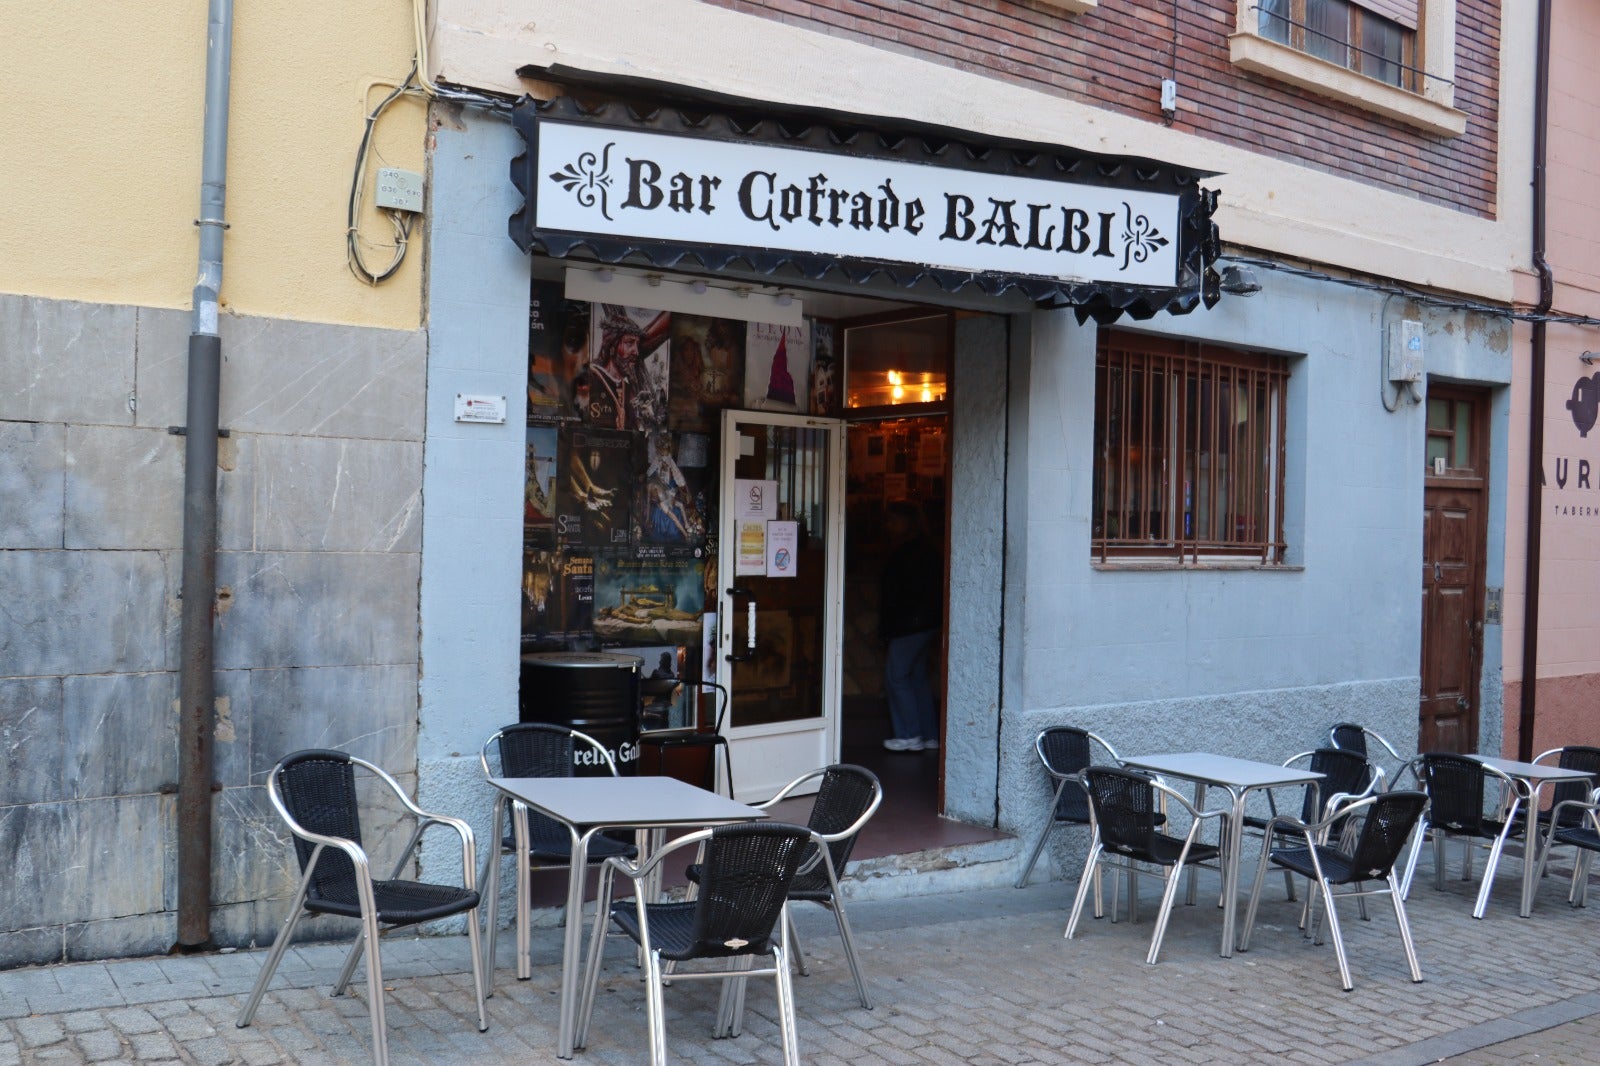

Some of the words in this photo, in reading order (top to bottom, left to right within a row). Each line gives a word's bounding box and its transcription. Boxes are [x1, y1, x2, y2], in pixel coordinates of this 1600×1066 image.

[621, 156, 722, 216] Bar
[737, 171, 925, 237] Cofrade
[939, 192, 1116, 258] BALBI
[1541, 457, 1600, 489] UR
